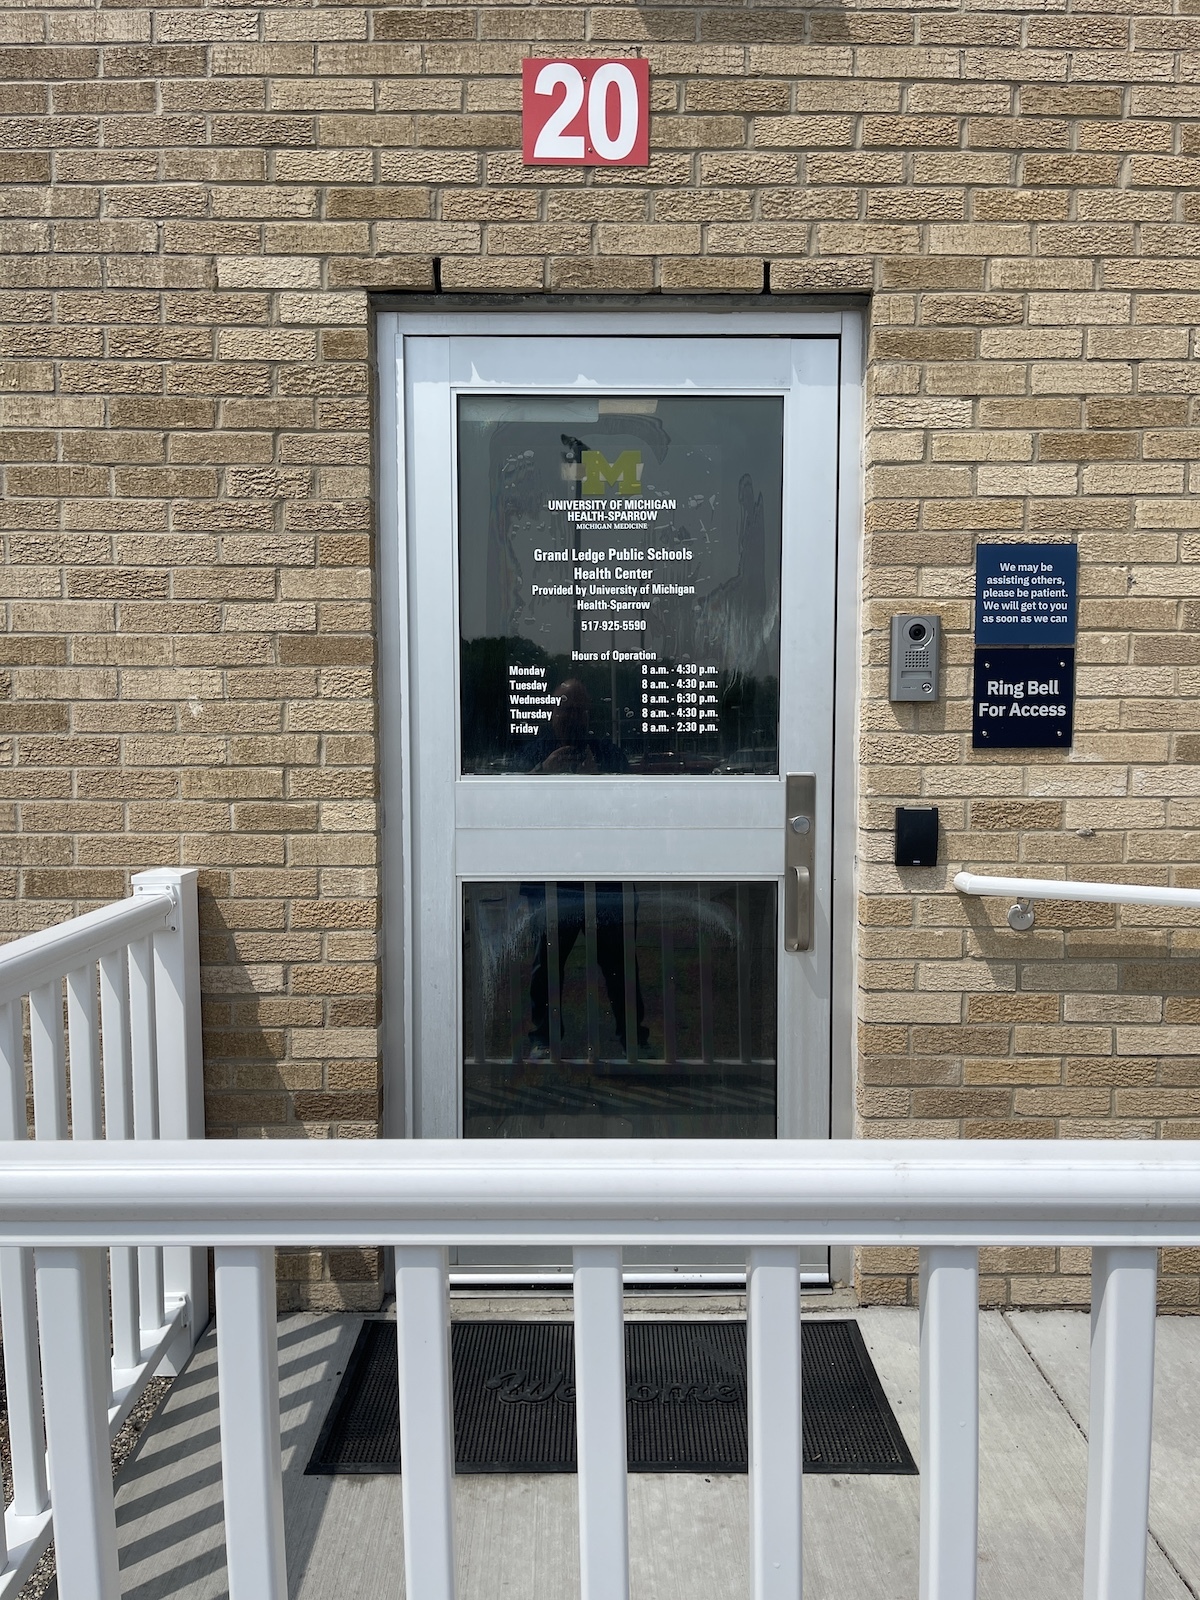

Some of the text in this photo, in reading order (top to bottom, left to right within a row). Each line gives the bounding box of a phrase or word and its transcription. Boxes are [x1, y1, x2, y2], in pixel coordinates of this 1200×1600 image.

[534, 62, 639, 160] 20
[580, 450, 642, 495] M
[548, 499, 677, 511] UNIVERSITY OF MICHIGAN
[567, 510, 658, 522] HEALTH-SPARROW
[575, 522, 648, 530] MICHIGAN MEDICINE
[533, 547, 693, 564] Grand Ledge Public Schools
[574, 567, 654, 580] Health Center
[999, 562, 1054, 574] We may be
[986, 574, 1066, 587] assisting others,
[531, 583, 695, 598] Provided by University of Michigan
[982, 587, 1069, 600] please be patient.
[577, 599, 651, 613] Health-Sparrow
[983, 600, 1068, 613] We will get to you
[581, 619, 647, 631] 517-925-5590
[982, 615, 1068, 624] as soon as we can
[571, 650, 657, 663] Hours of Operation
[509, 665, 546, 678] Monday
[641, 664, 648, 675] 8
[649, 666, 670, 675] a.m.
[676, 663, 697, 674] 4:30
[698, 665, 719, 676] p.m.
[509, 679, 548, 692] Tuesday
[641, 679, 648, 690] 8
[649, 681, 670, 690] a.m.
[676, 678, 697, 689] 4:30
[698, 680, 719, 691] p.m.
[987, 680, 1060, 699] Ring Bell
[509, 694, 562, 707] Wednesday
[641, 693, 648, 704] 8
[649, 695, 670, 704] a.m.
[676, 692, 697, 703] 6:30
[698, 694, 719, 705] p.m.
[509, 708, 553, 721] Thursday
[641, 708, 648, 719] 8
[649, 710, 670, 719] a.m.
[676, 707, 697, 718] 4:30
[698, 709, 719, 720] p.m.
[978, 702, 1067, 717] For Access
[510, 723, 540, 736] Friday
[641, 722, 648, 733] 8
[649, 724, 670, 733] a.m.
[676, 721, 697, 732] 2:30
[698, 723, 719, 734] p.m.
